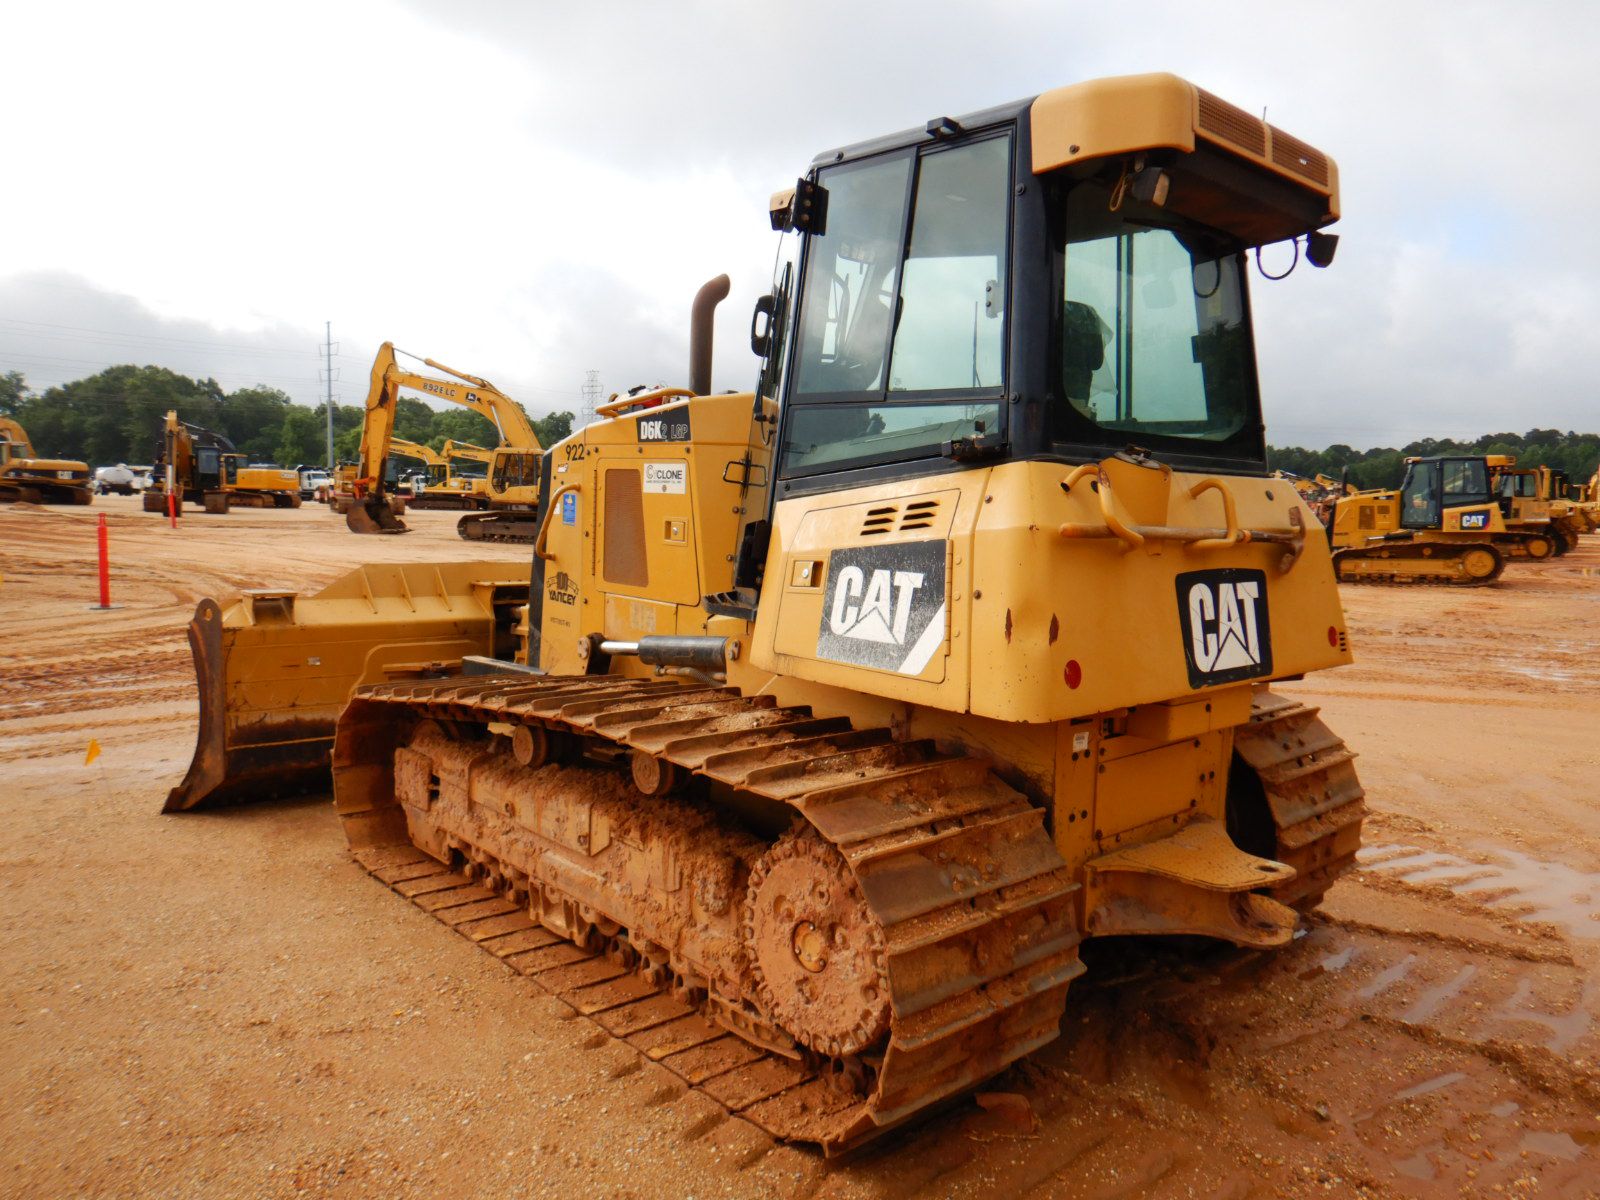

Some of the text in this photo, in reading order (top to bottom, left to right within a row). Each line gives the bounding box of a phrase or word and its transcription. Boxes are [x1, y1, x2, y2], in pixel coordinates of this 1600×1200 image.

[565, 443, 585, 461] 922
[1462, 514, 1485, 527] CAT
[830, 565, 924, 646] CAT
[1188, 581, 1261, 673] CAT
